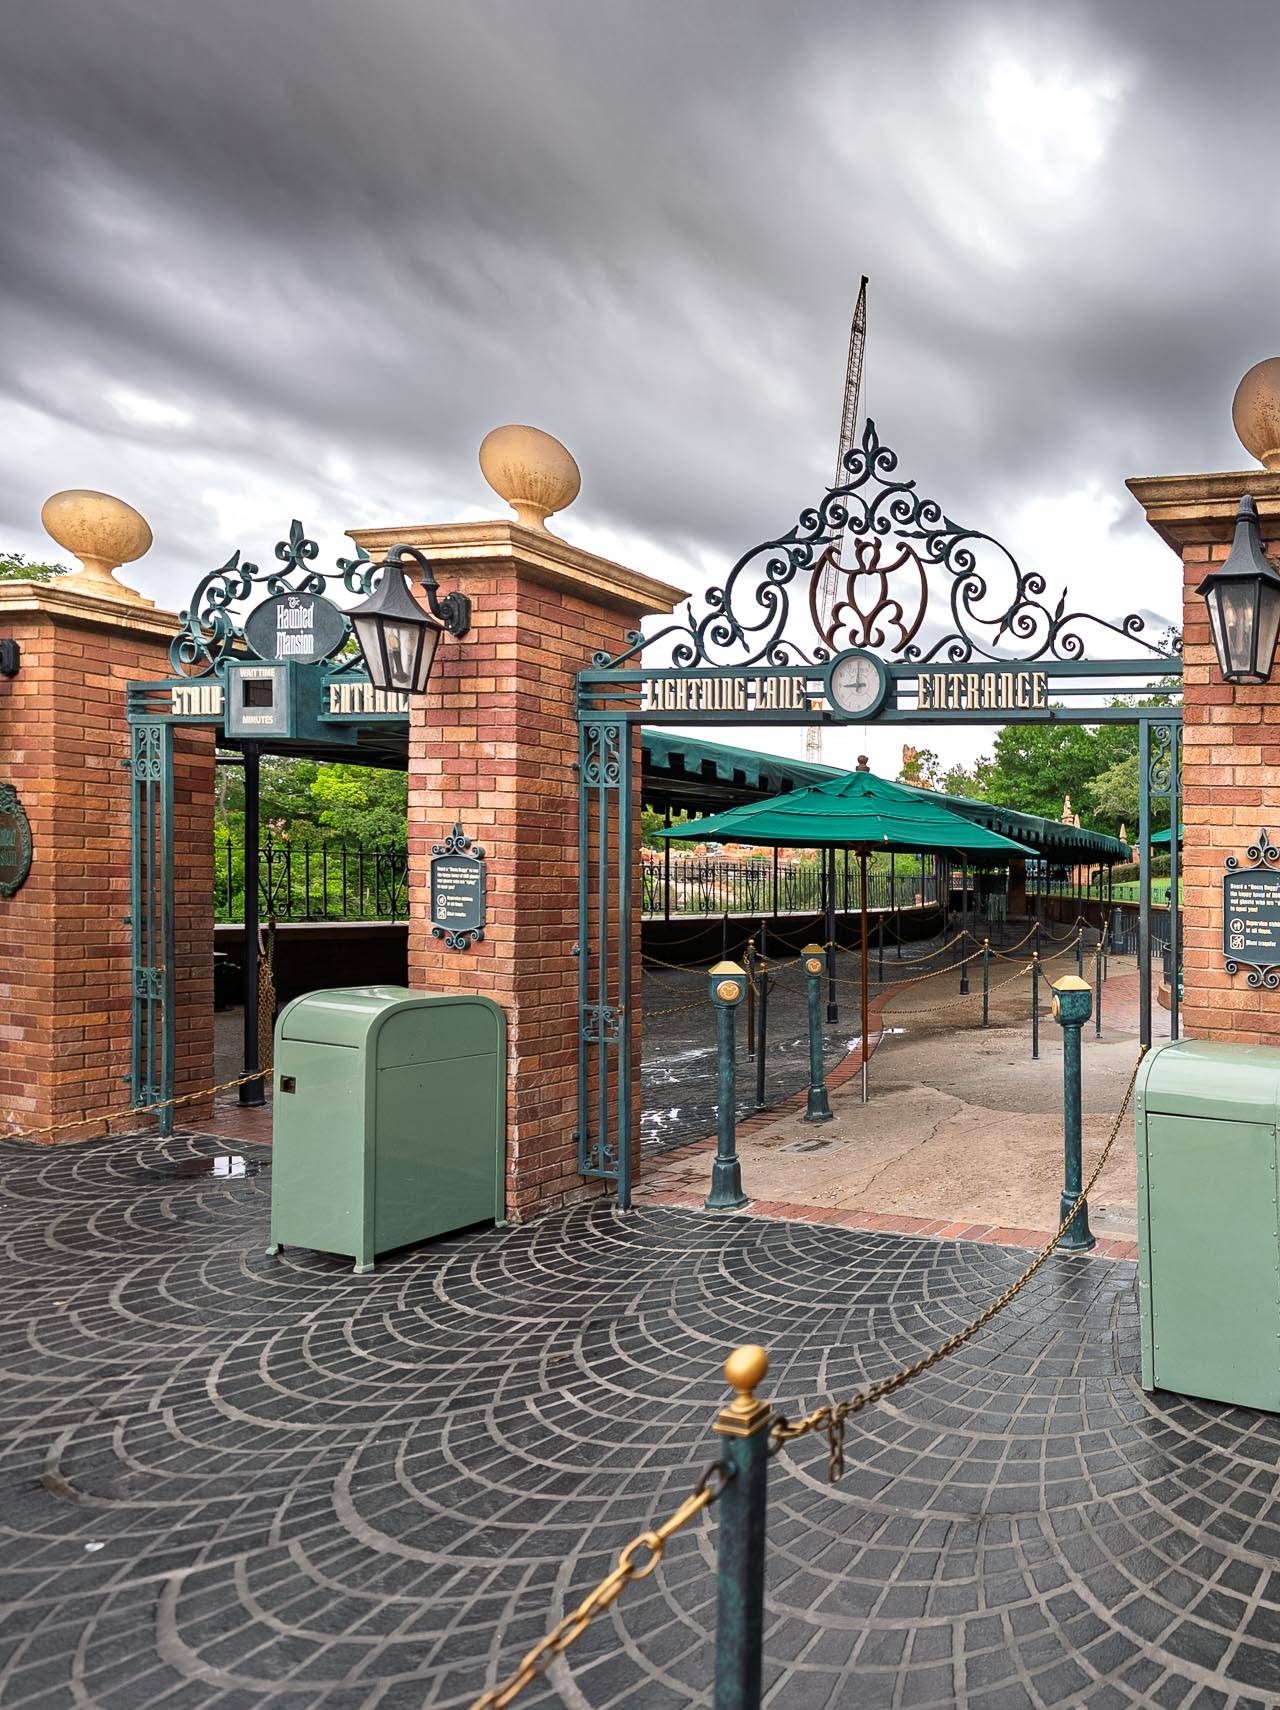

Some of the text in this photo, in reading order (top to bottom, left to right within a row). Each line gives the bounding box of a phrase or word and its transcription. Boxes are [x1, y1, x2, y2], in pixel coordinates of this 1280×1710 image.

[276, 602, 314, 629] Haunted
[275, 630, 314, 660] Mansion
[239, 668, 276, 678] WAIT TIME
[646, 672, 1048, 711] LIGHTNING LANE ENTRANCE
[242, 715, 274, 724] MINUTES
